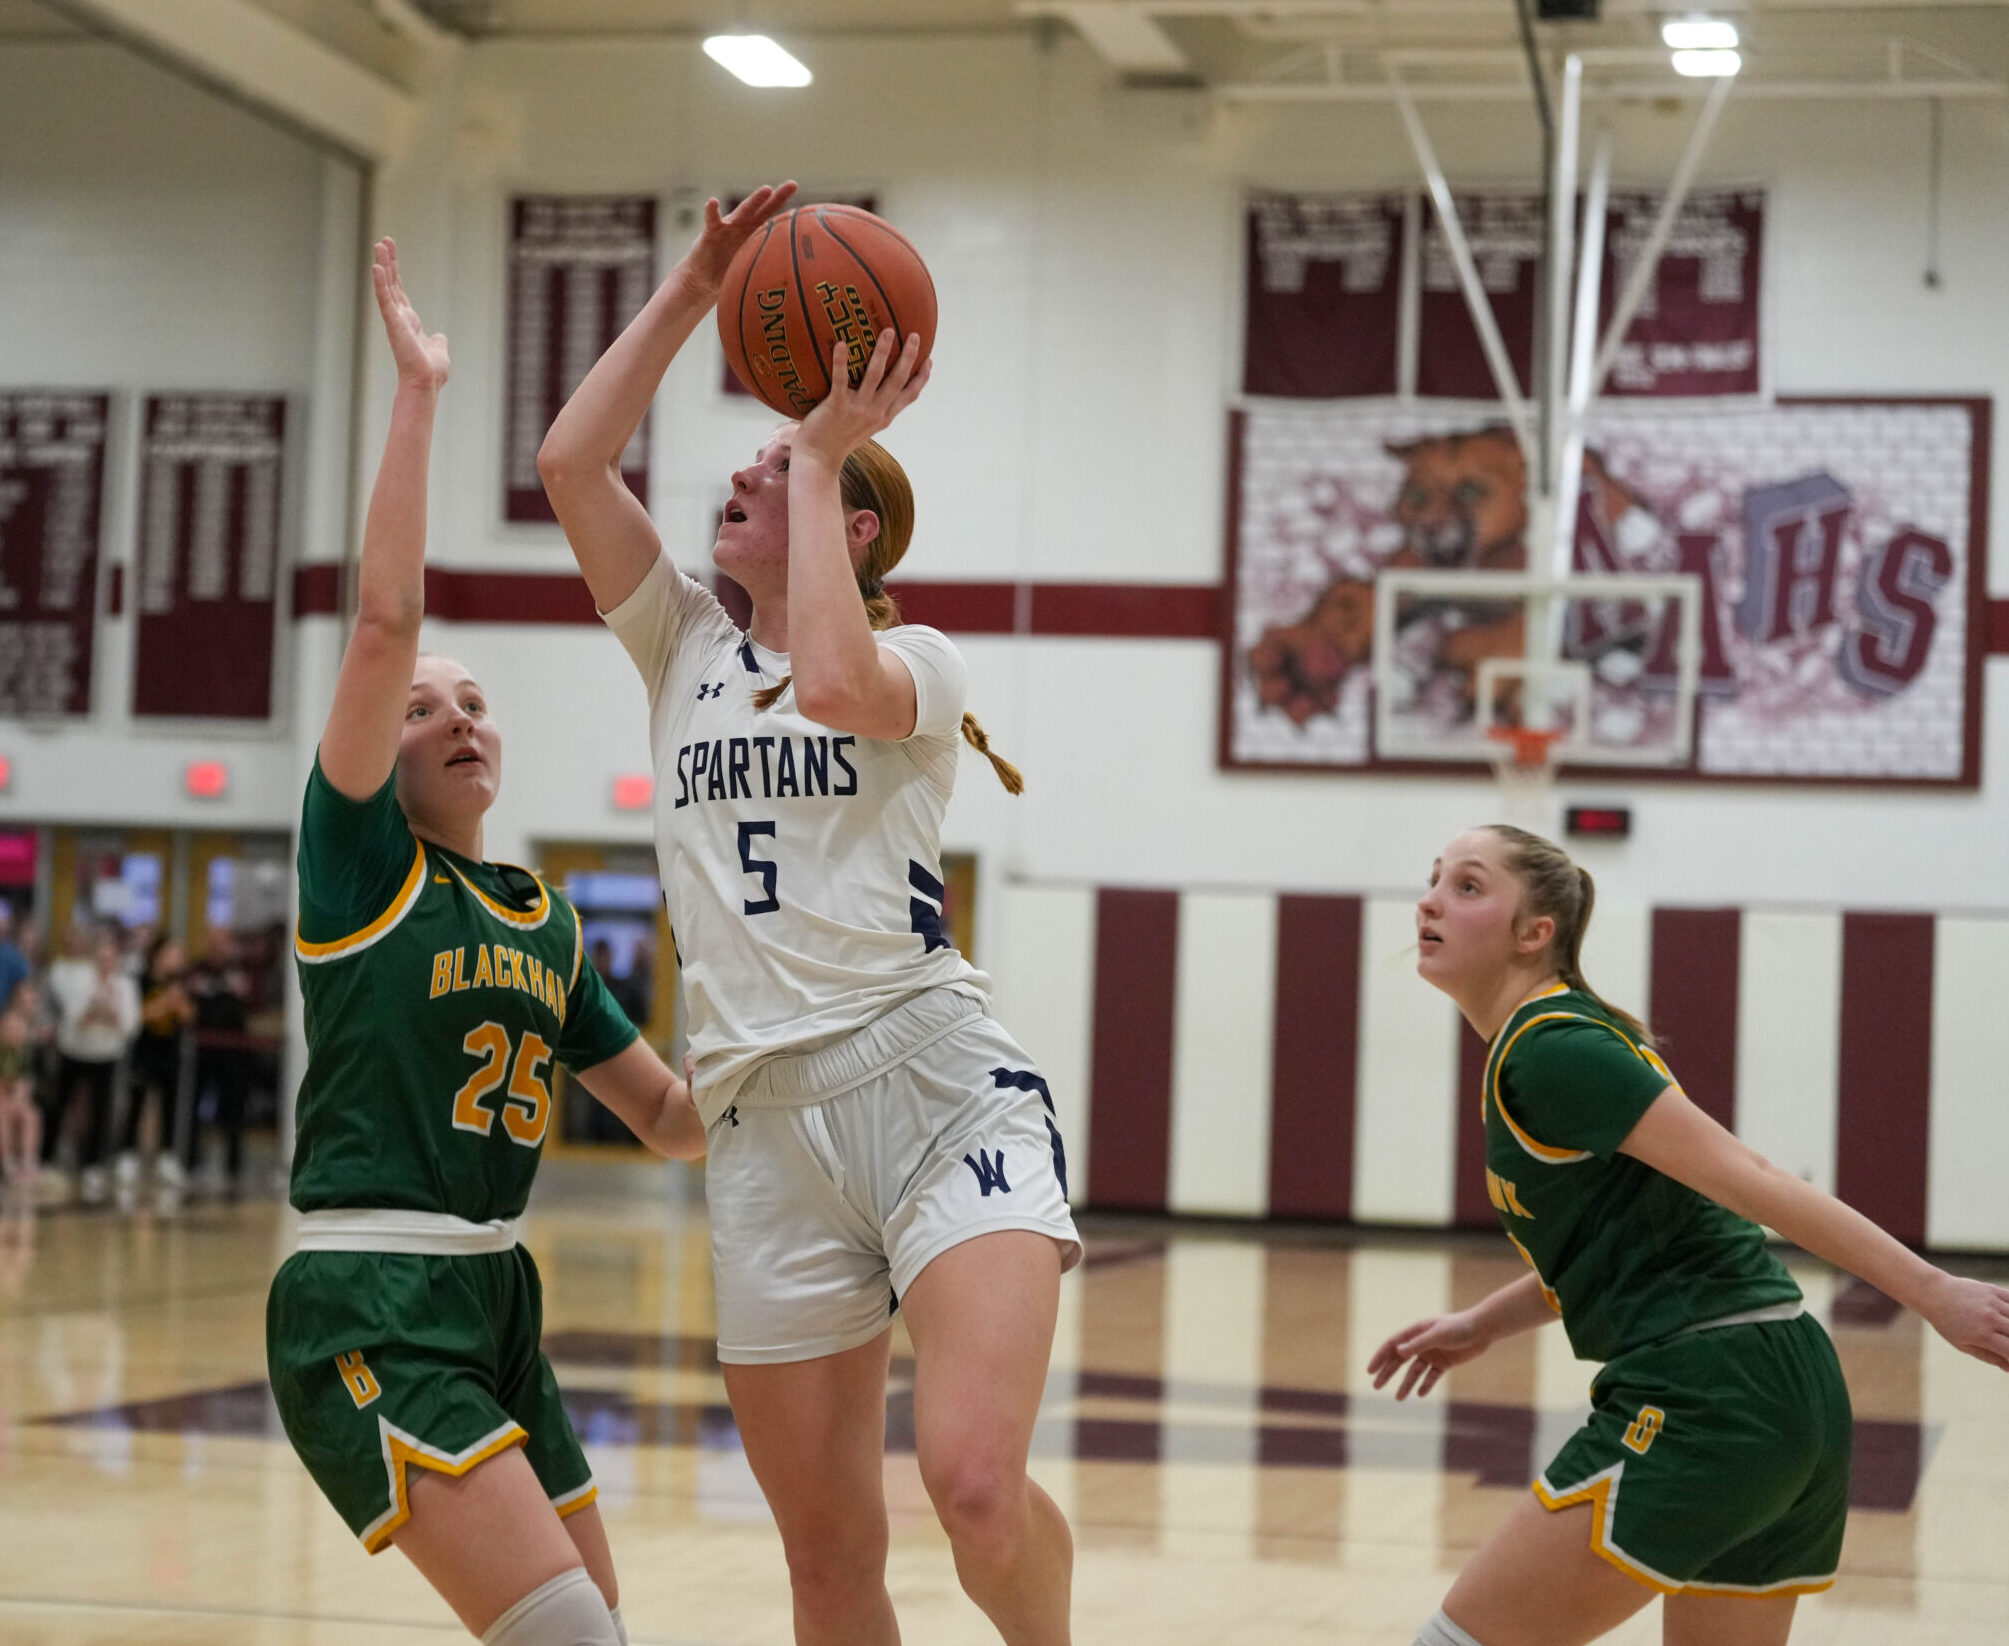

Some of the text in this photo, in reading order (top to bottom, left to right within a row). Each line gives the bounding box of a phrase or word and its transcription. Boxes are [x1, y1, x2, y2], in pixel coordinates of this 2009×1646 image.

[757, 287, 817, 415] PALDING
[816, 281, 870, 386] EGACY
[845, 284, 878, 350] 000
[675, 736, 858, 809] SPARTANS
[737, 821, 780, 915] 5
[452, 1020, 552, 1149] 25
